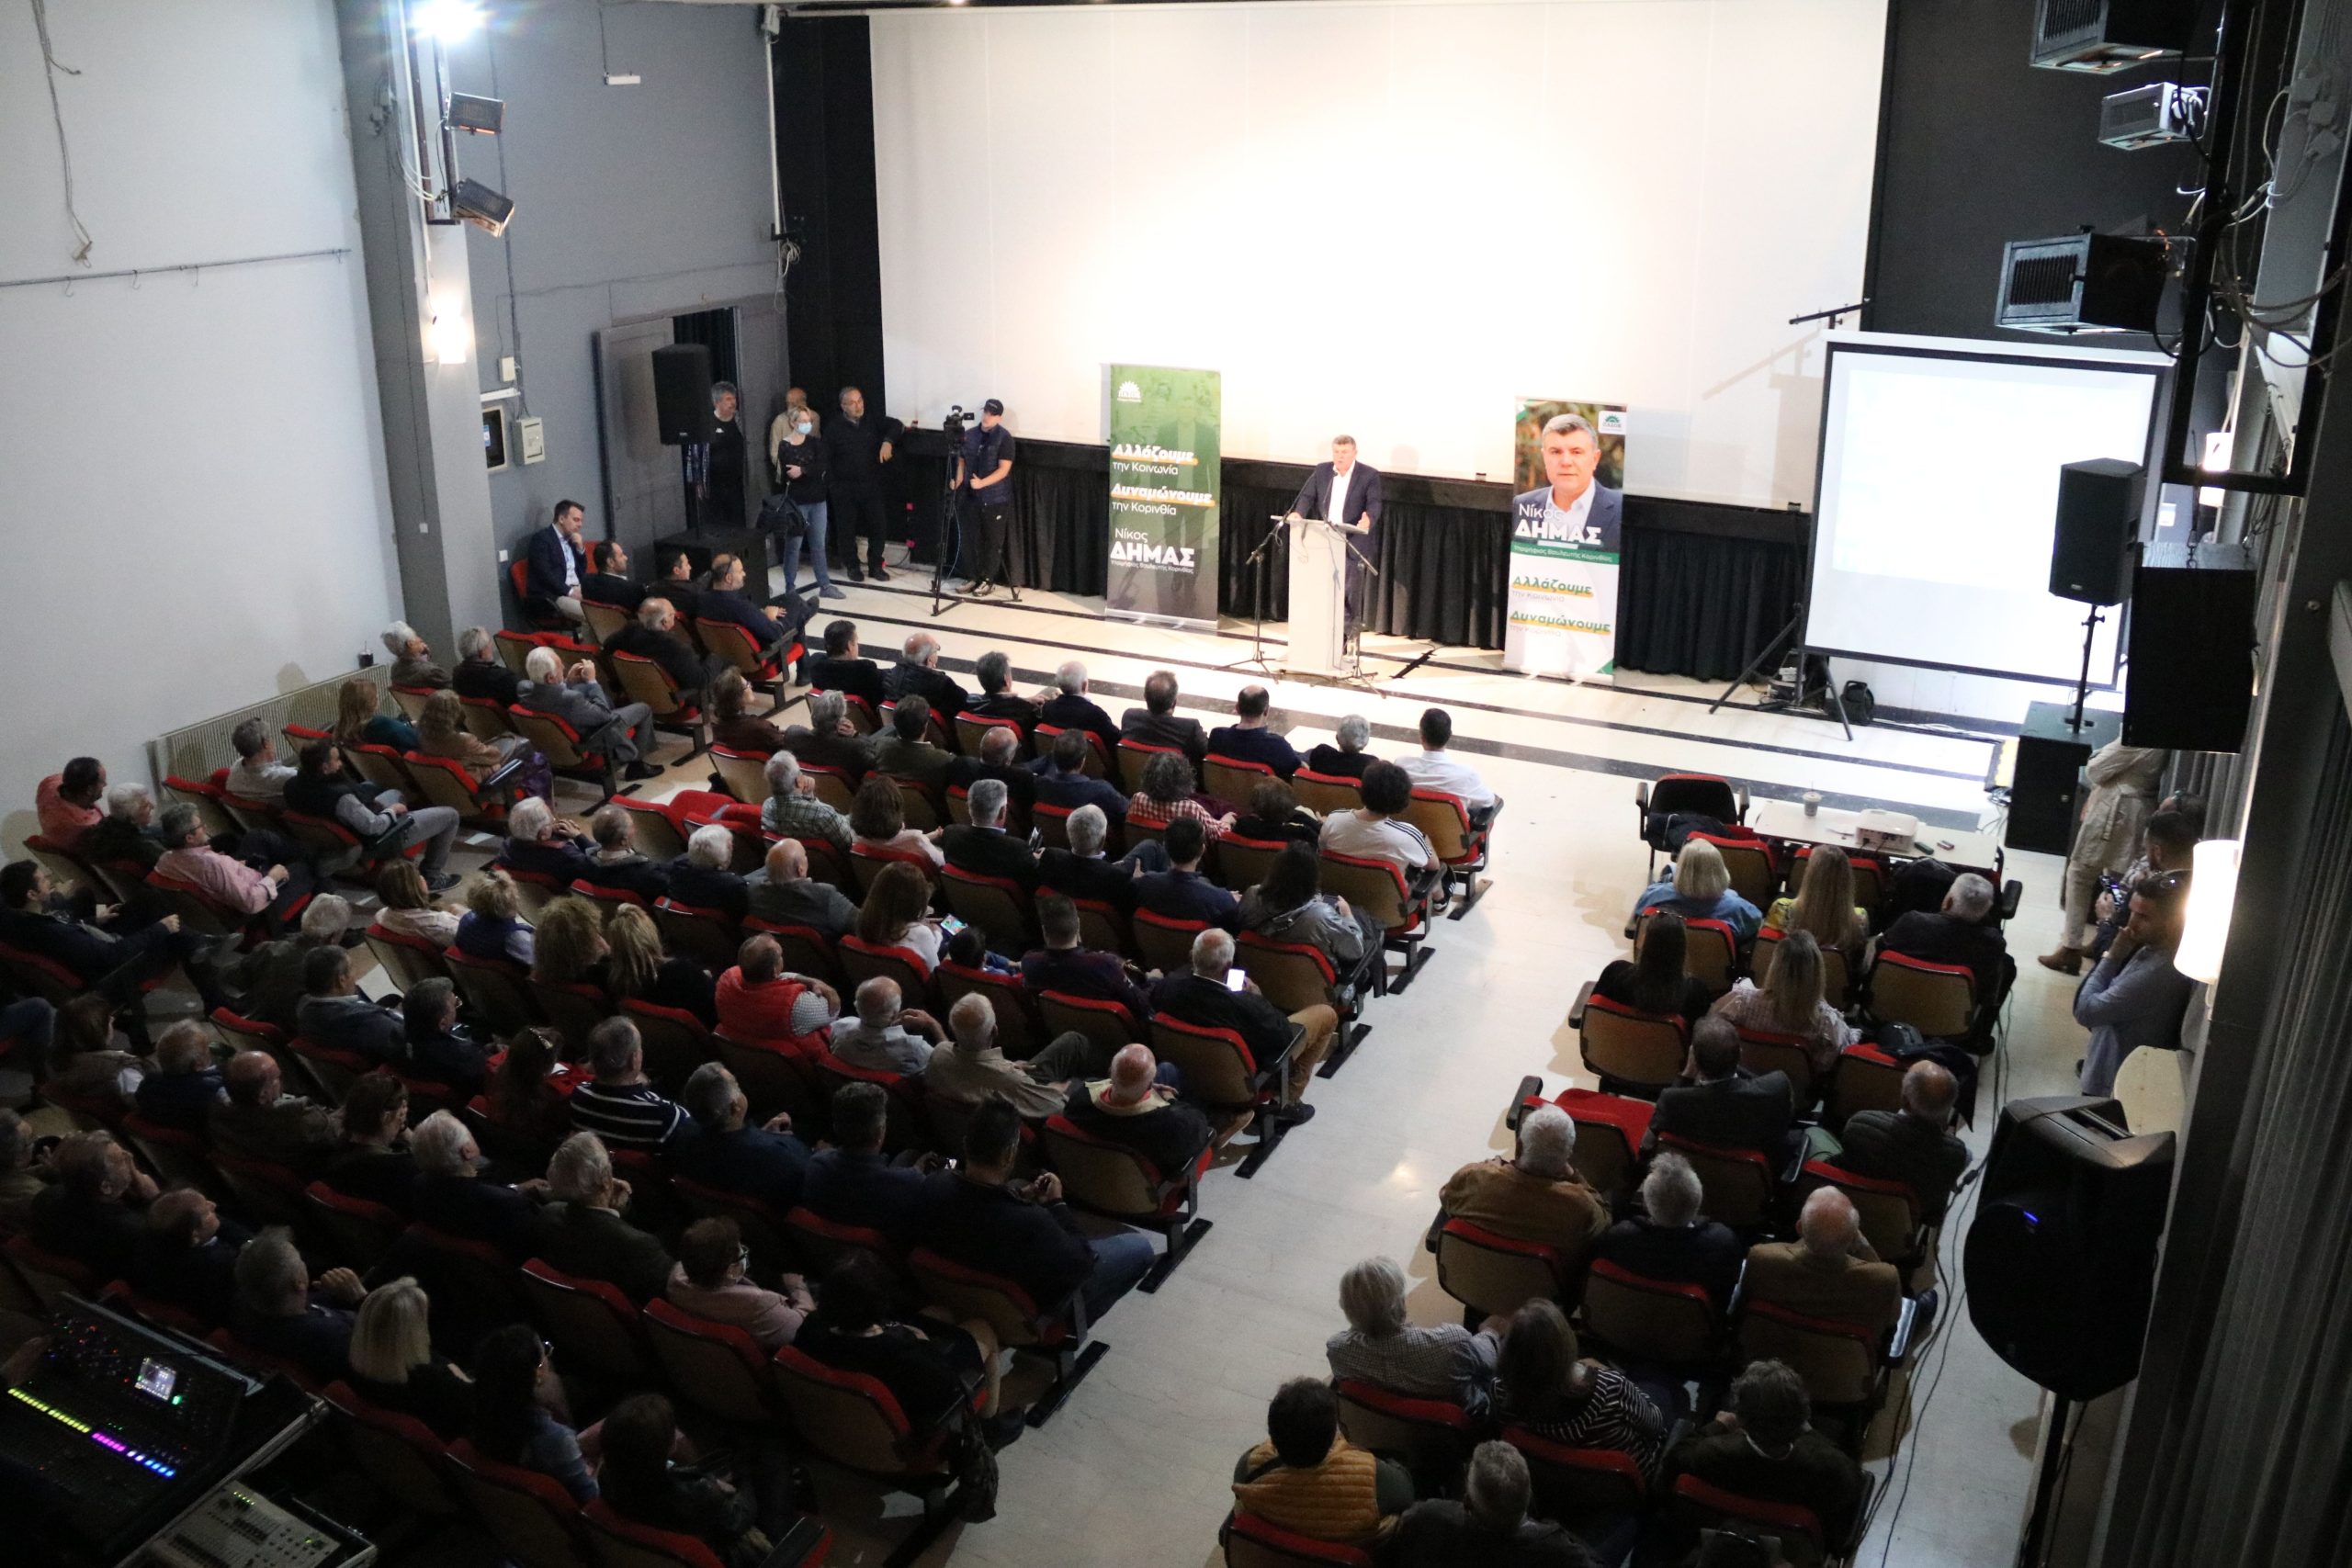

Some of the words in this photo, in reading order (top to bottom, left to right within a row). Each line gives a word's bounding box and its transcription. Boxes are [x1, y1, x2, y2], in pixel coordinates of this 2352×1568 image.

[1113, 444, 1194, 464] Αλλάζουμε
[1113, 462, 1130, 473] την
[1131, 462, 1179, 476] Κοινωνία
[1111, 482, 1213, 505] Δυναμώνουμε
[1112, 502, 1129, 513] την
[1131, 502, 1177, 515] Κορινθία
[1519, 503, 1563, 521] Νίκος
[1114, 527, 1148, 543] Νίκος
[1515, 519, 1602, 545] ΔΗΜΑΣ
[1110, 540, 1194, 568] ΔΗΜΑΣ
[1512, 576, 1592, 595] Αλλάζουμε
[1510, 610, 1611, 633] Δυναμώνουμε
